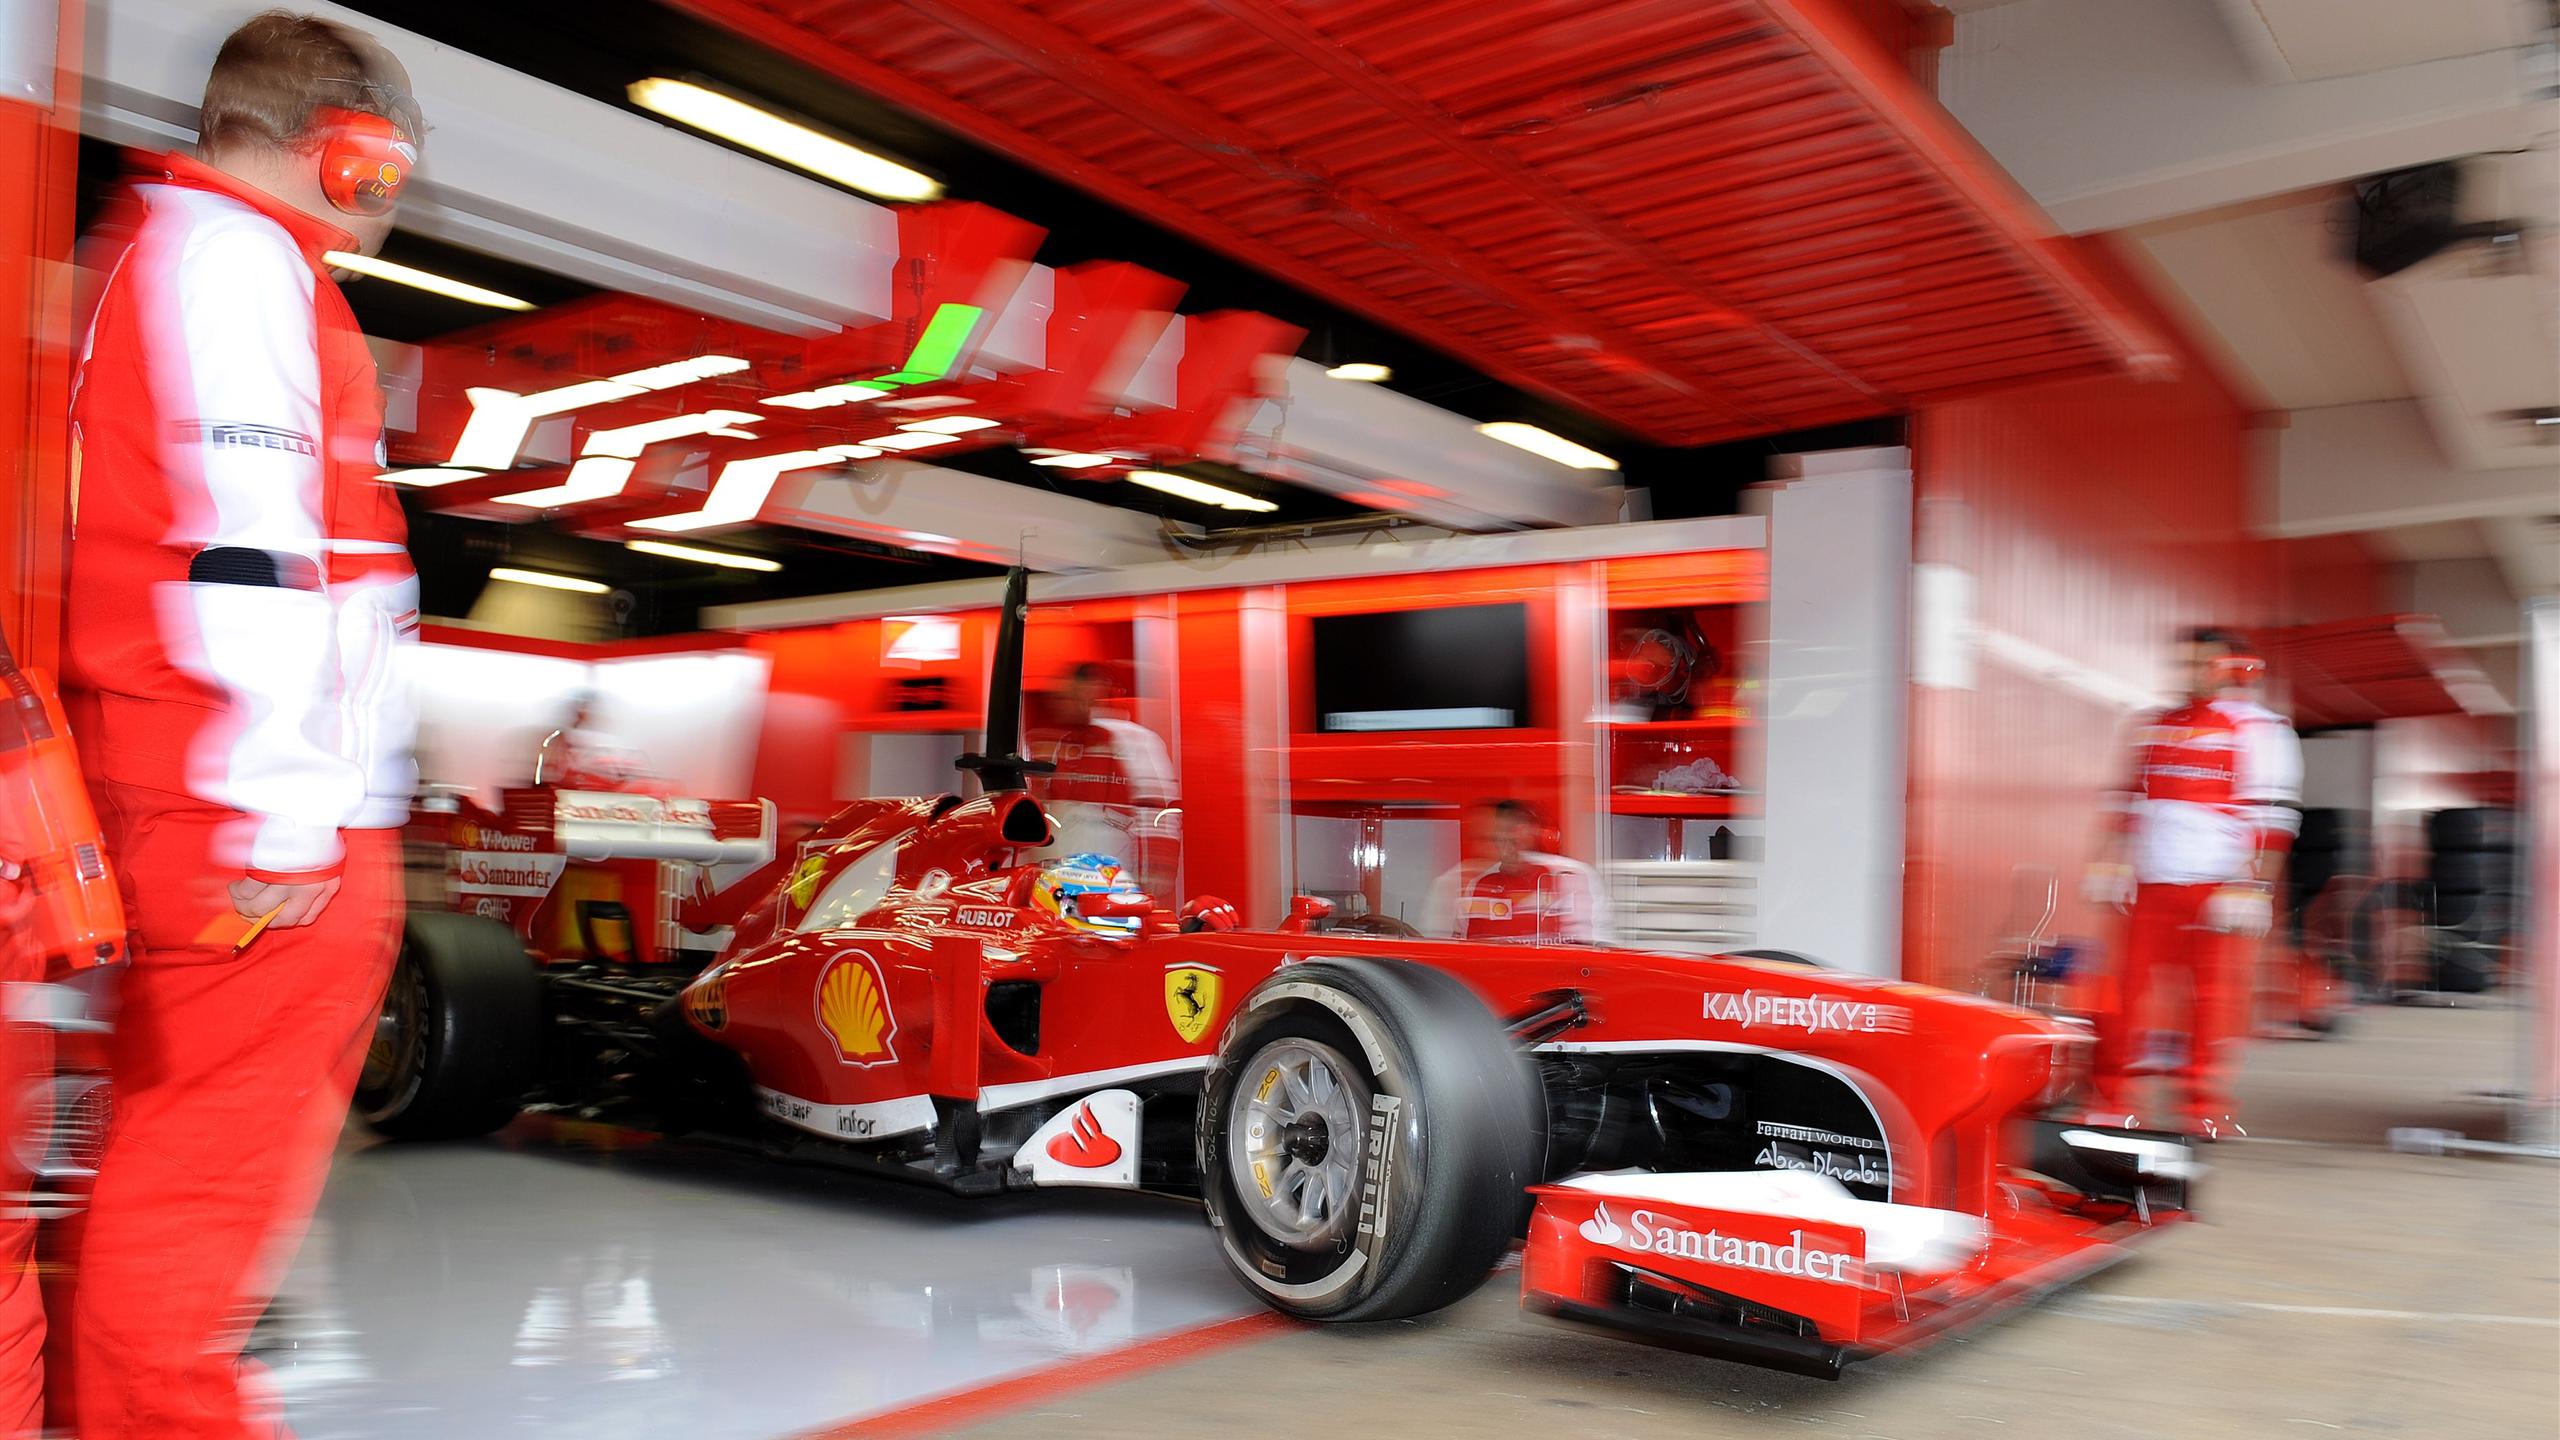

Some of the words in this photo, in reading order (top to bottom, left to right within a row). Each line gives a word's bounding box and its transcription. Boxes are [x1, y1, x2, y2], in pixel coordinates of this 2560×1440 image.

[212, 423, 317, 457] PIRELLI
[478, 860, 551, 889] Santander
[955, 909, 1014, 928] HUBLOT
[1703, 988, 1862, 1036] KASPERSKY
[837, 1109, 877, 1135] infor
[1756, 1120, 1814, 1142] Ferrari
[1815, 1131, 1873, 1149] WORLD
[1357, 1093, 1402, 1239] PIRELLI
[1755, 1141, 1806, 1169] Abu
[1812, 1151, 1879, 1184] Dhabi
[1629, 1209, 1851, 1282] Santander
